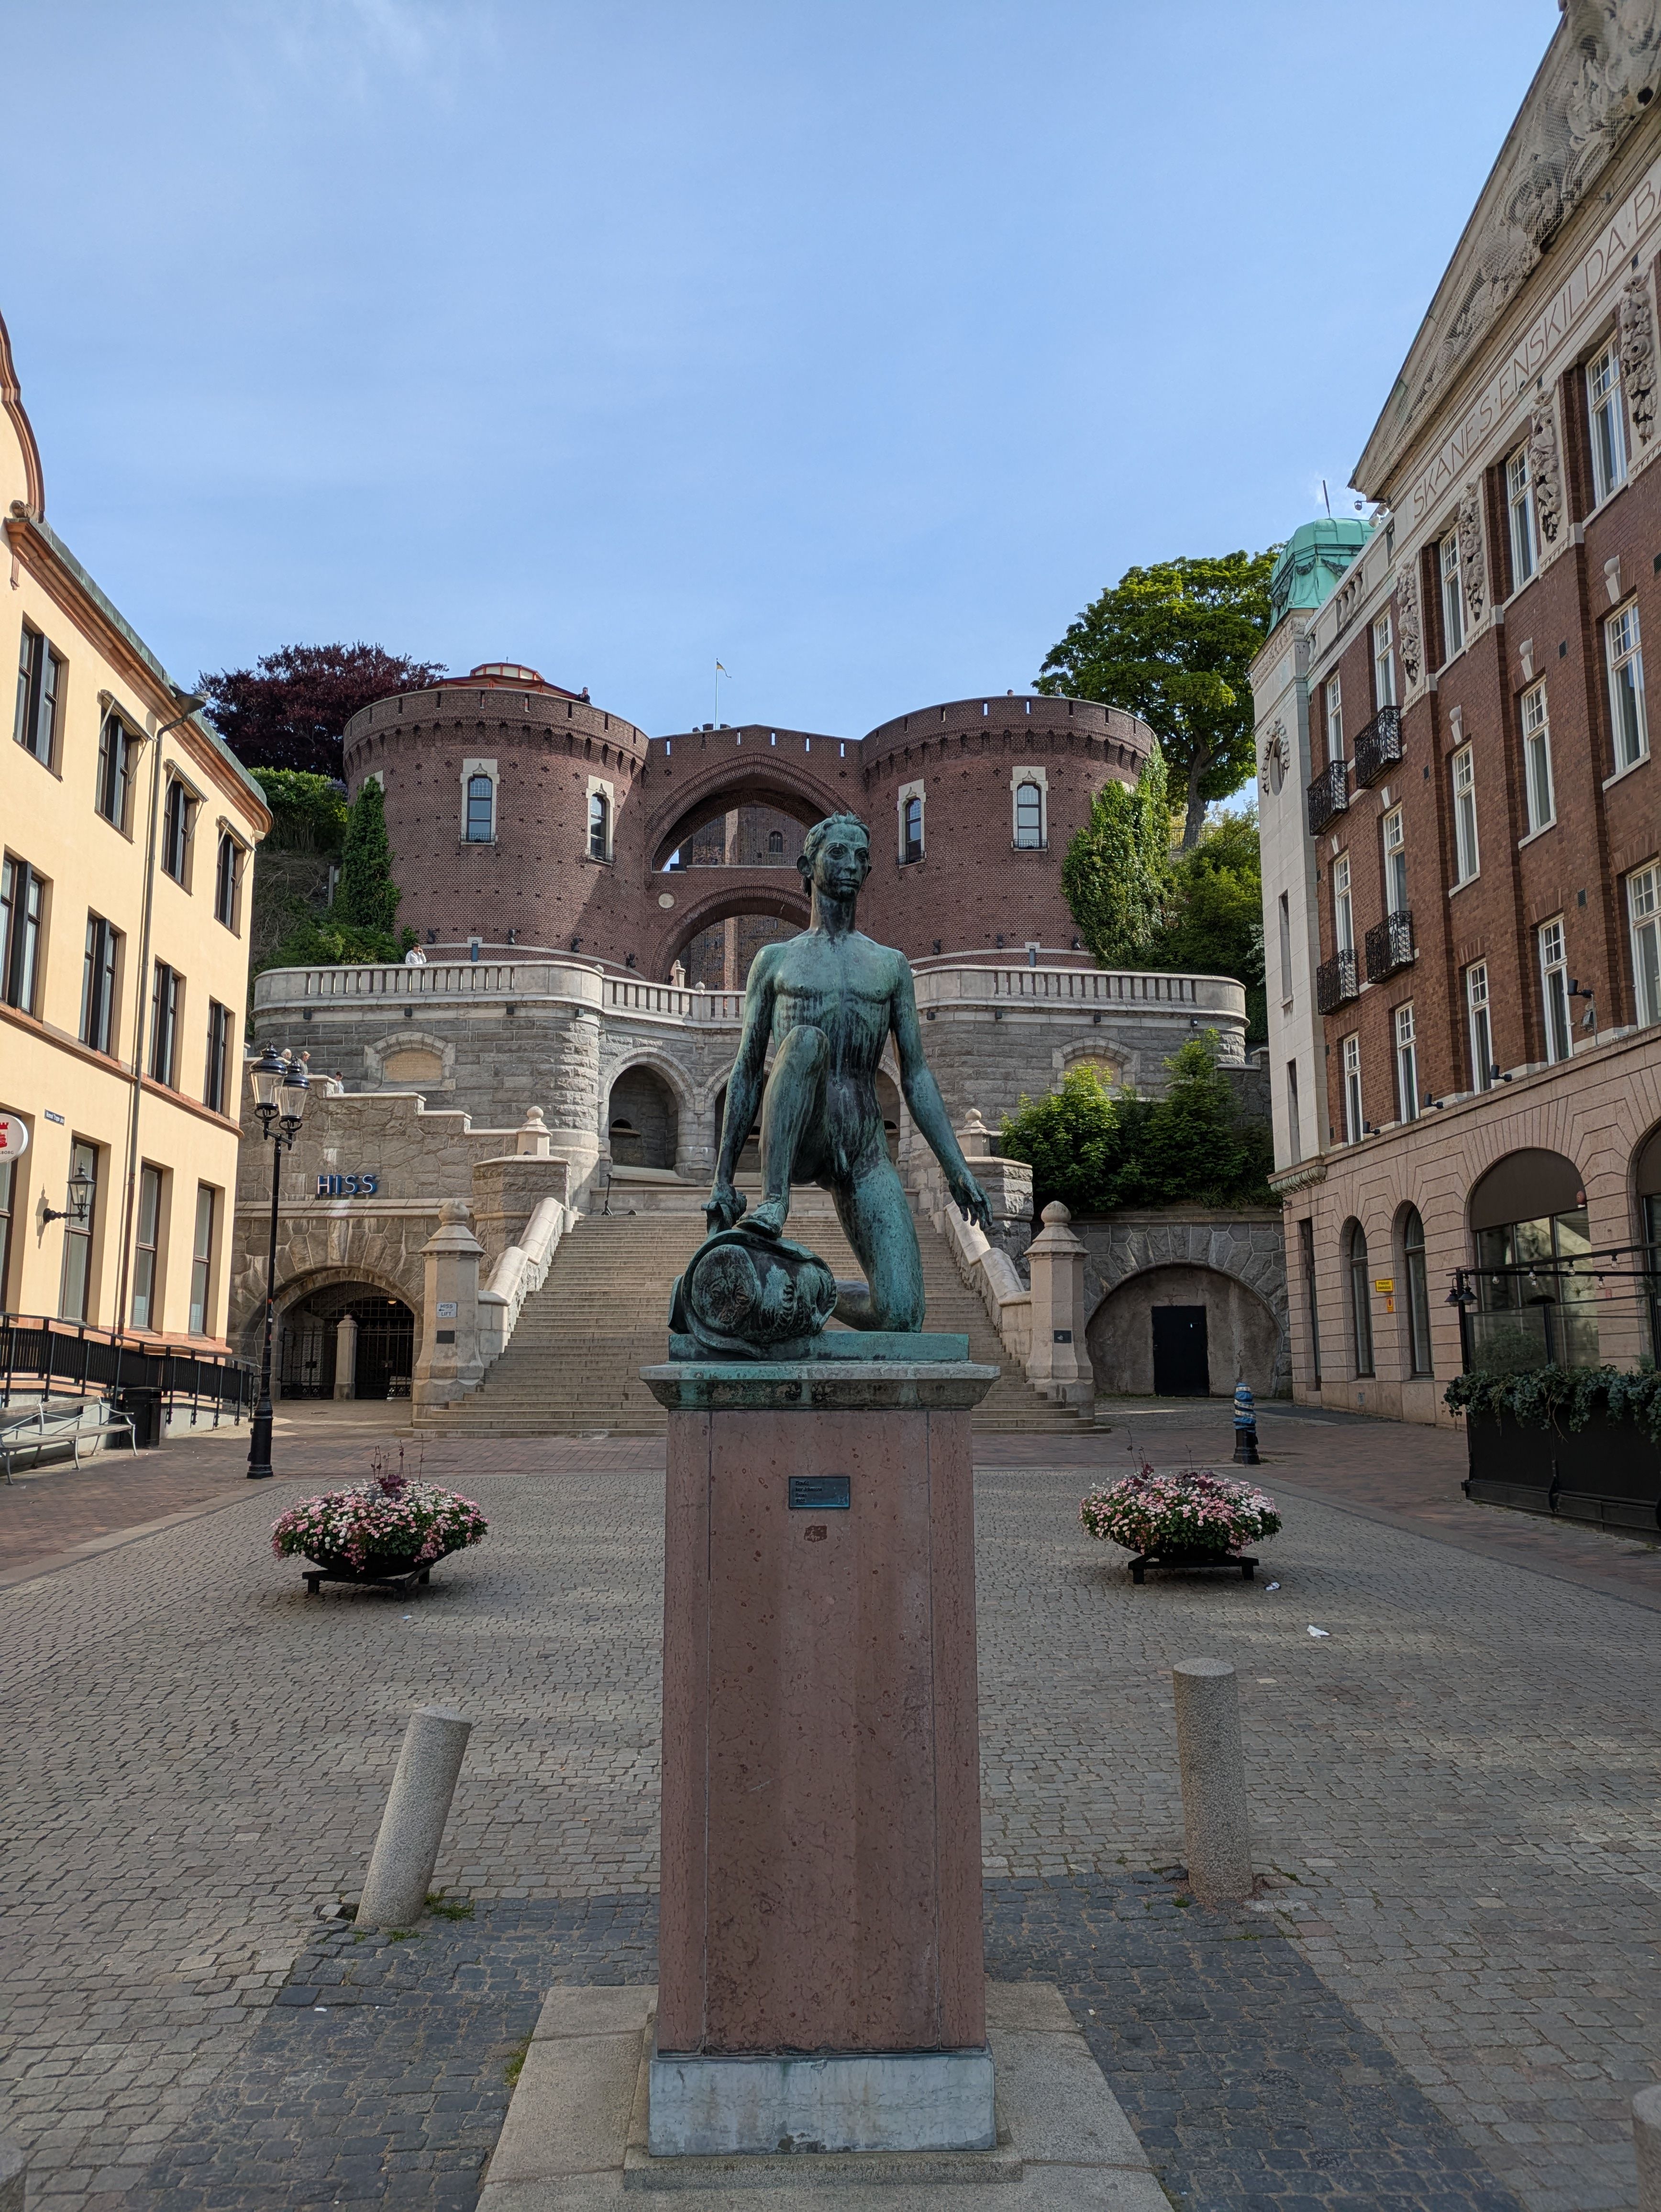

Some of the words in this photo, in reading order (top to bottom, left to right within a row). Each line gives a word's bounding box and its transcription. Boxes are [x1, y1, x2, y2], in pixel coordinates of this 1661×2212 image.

[1414, 393, 1493, 521] SKÅNES
[1499, 225, 1626, 410] ENSKILDA
[1633, 179, 1661, 235] B
[317, 1174, 377, 1195] HISS
